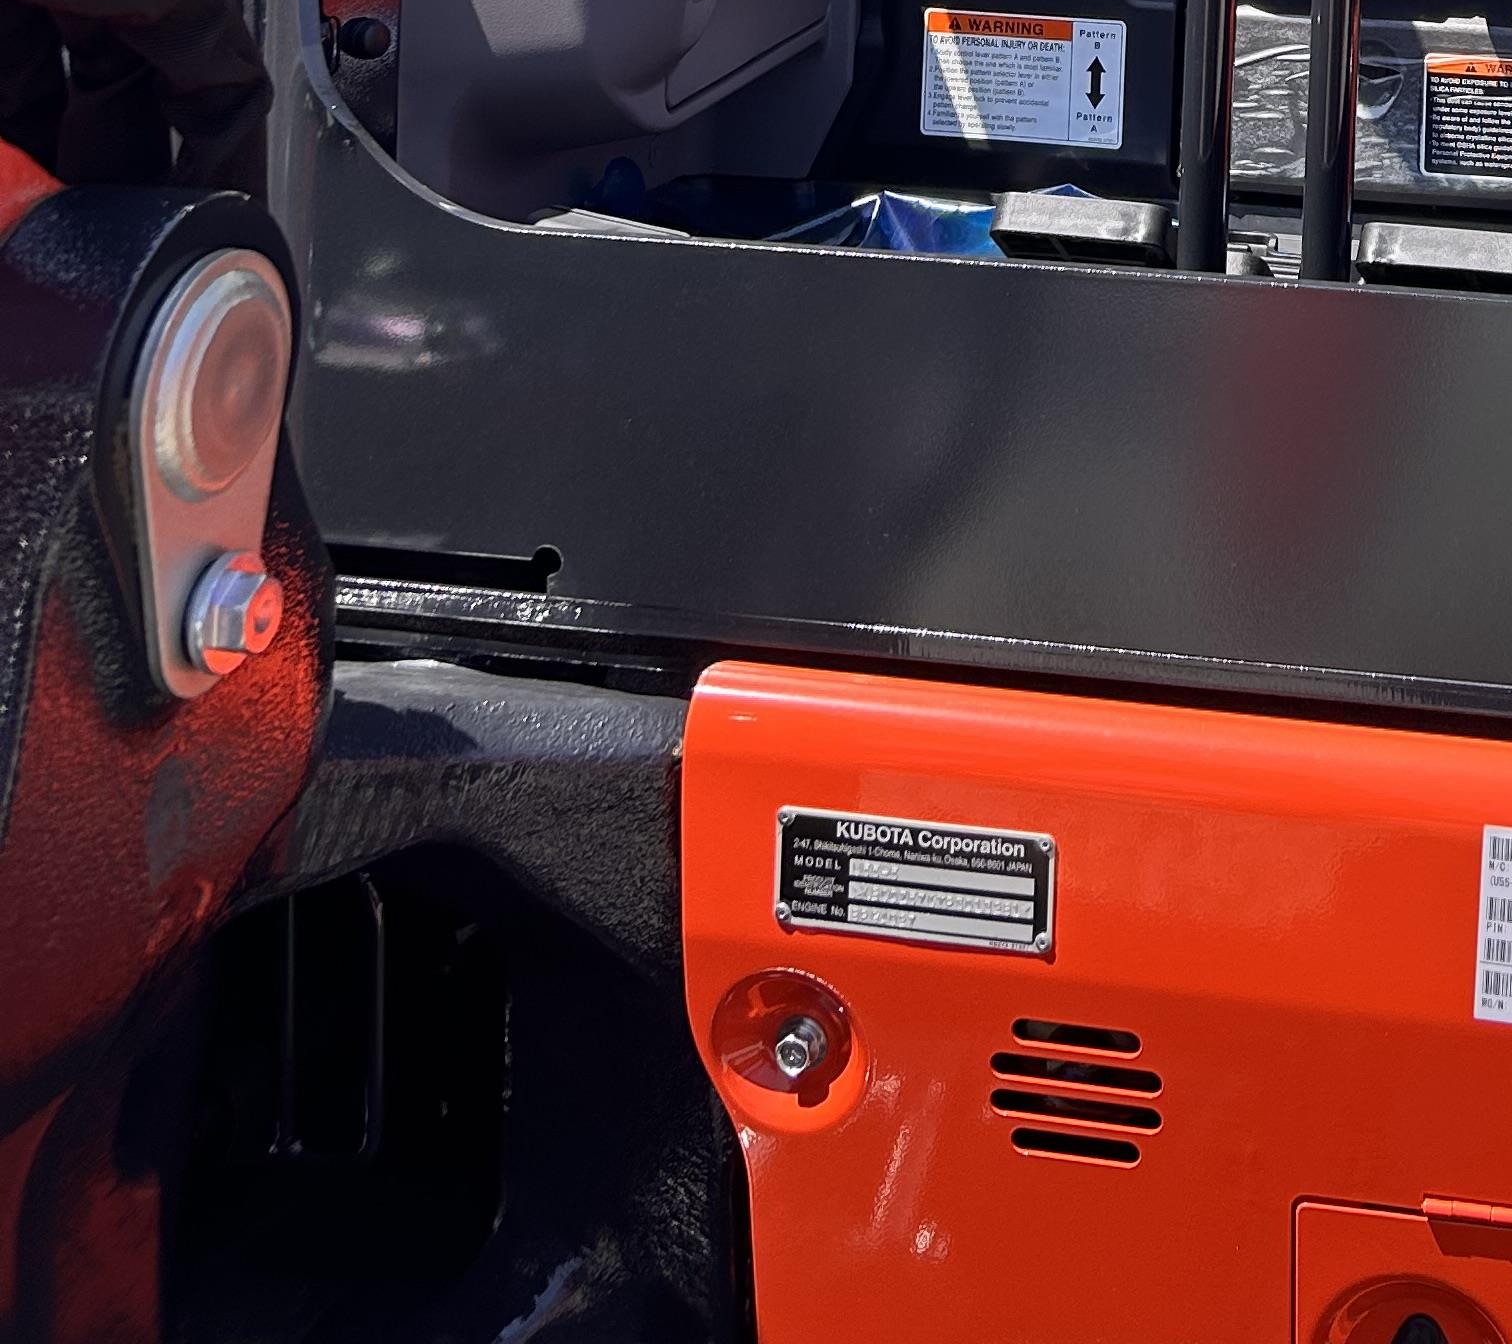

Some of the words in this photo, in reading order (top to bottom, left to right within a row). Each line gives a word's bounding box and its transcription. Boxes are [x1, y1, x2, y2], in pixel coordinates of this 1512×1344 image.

[968, 18, 1044, 36] WARNING
[1080, 30, 1116, 39] Pattern
[962, 37, 999, 47] PERSONAL
[1001, 40, 1025, 49] INJURY
[1028, 42, 1038, 51] OR
[1095, 42, 1100, 50] B
[1076, 112, 1113, 122] Pattern
[836, 821, 913, 846] KUBOTA
[918, 831, 1026, 858] Corporation
[793, 837, 812, 850] 2-47,
[1006, 862, 1033, 874] JAPAN
[794, 855, 841, 870] MODEL
[791, 900, 827, 915] ENGINE
[831, 905, 845, 916] No.
